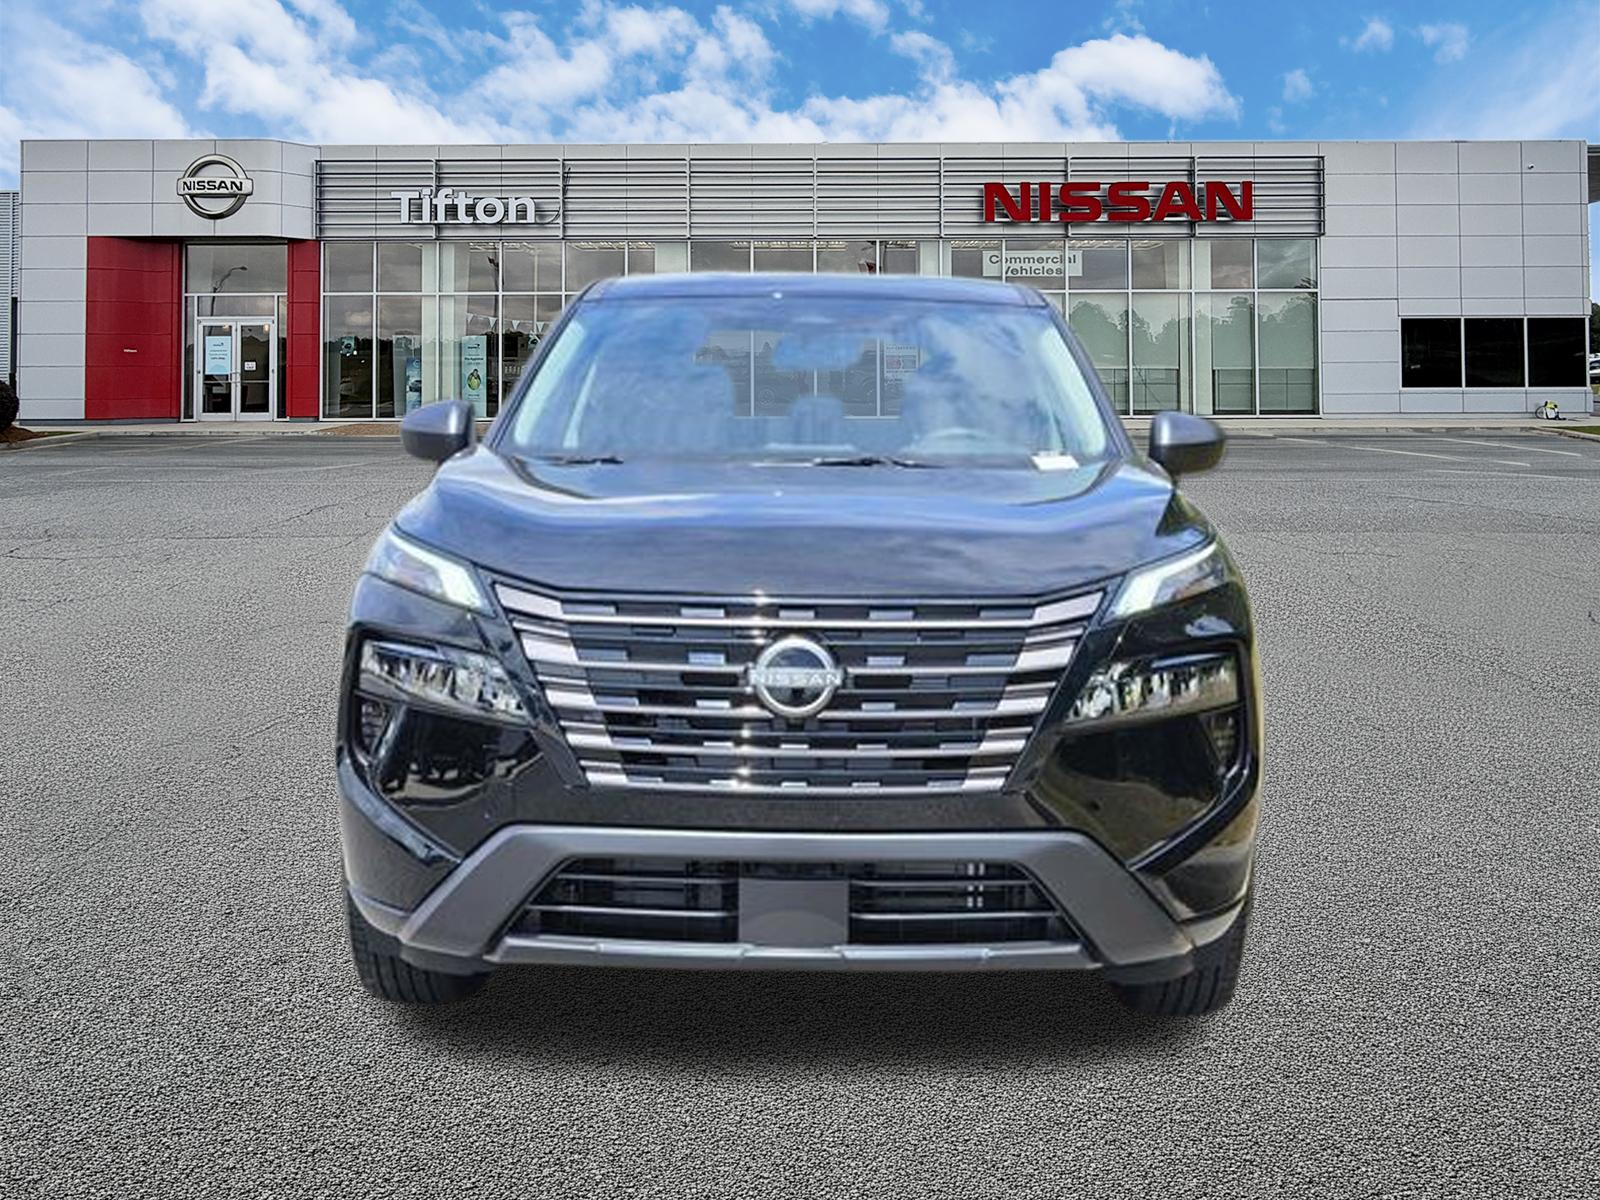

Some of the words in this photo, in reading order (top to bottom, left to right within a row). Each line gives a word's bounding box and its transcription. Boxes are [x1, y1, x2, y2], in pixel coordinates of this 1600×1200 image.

[182, 180, 243, 191] NISSAN
[391, 188, 536, 224] Tifton
[984, 181, 1253, 222] NISSAN
[748, 671, 841, 687] NISSAN
